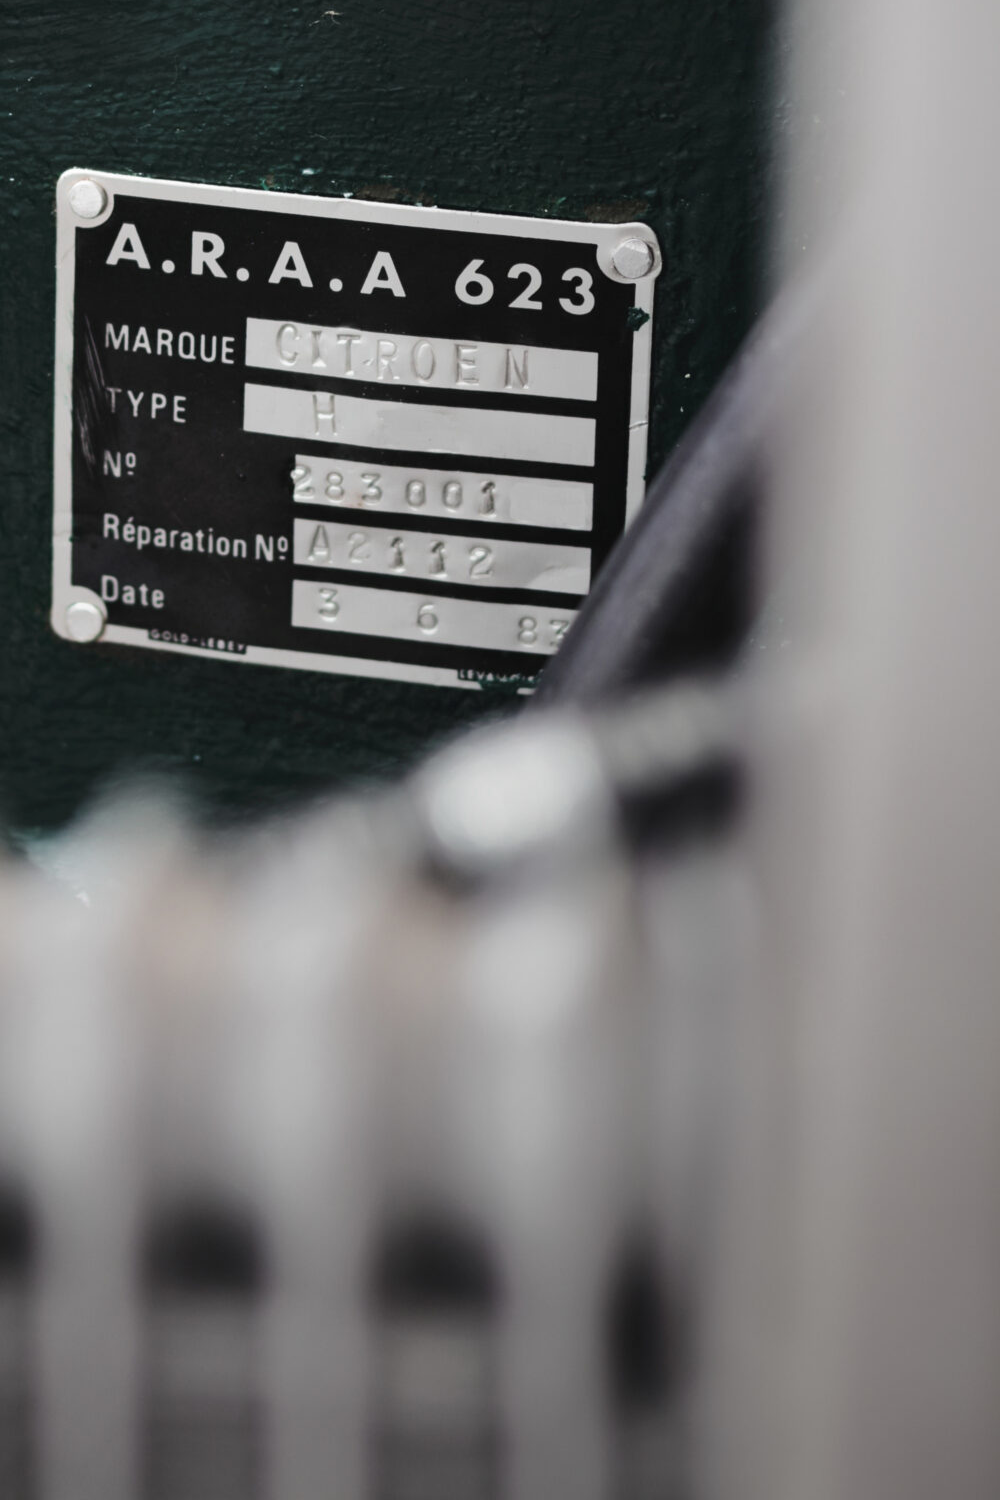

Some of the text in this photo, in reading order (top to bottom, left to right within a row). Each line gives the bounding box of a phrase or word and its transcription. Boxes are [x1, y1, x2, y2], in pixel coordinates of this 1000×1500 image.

[105, 222, 596, 316] A.R.A.A 623
[105, 322, 530, 390] MARQUE CITROEN
[106, 386, 338, 436] TYPE H
[290, 464, 497, 519] 283001
[103, 512, 247, 559] Réparation
[307, 523, 495, 580] A2112
[101, 574, 165, 610] Date
[317, 587, 341, 623] 3
[416, 603, 439, 636] 6
